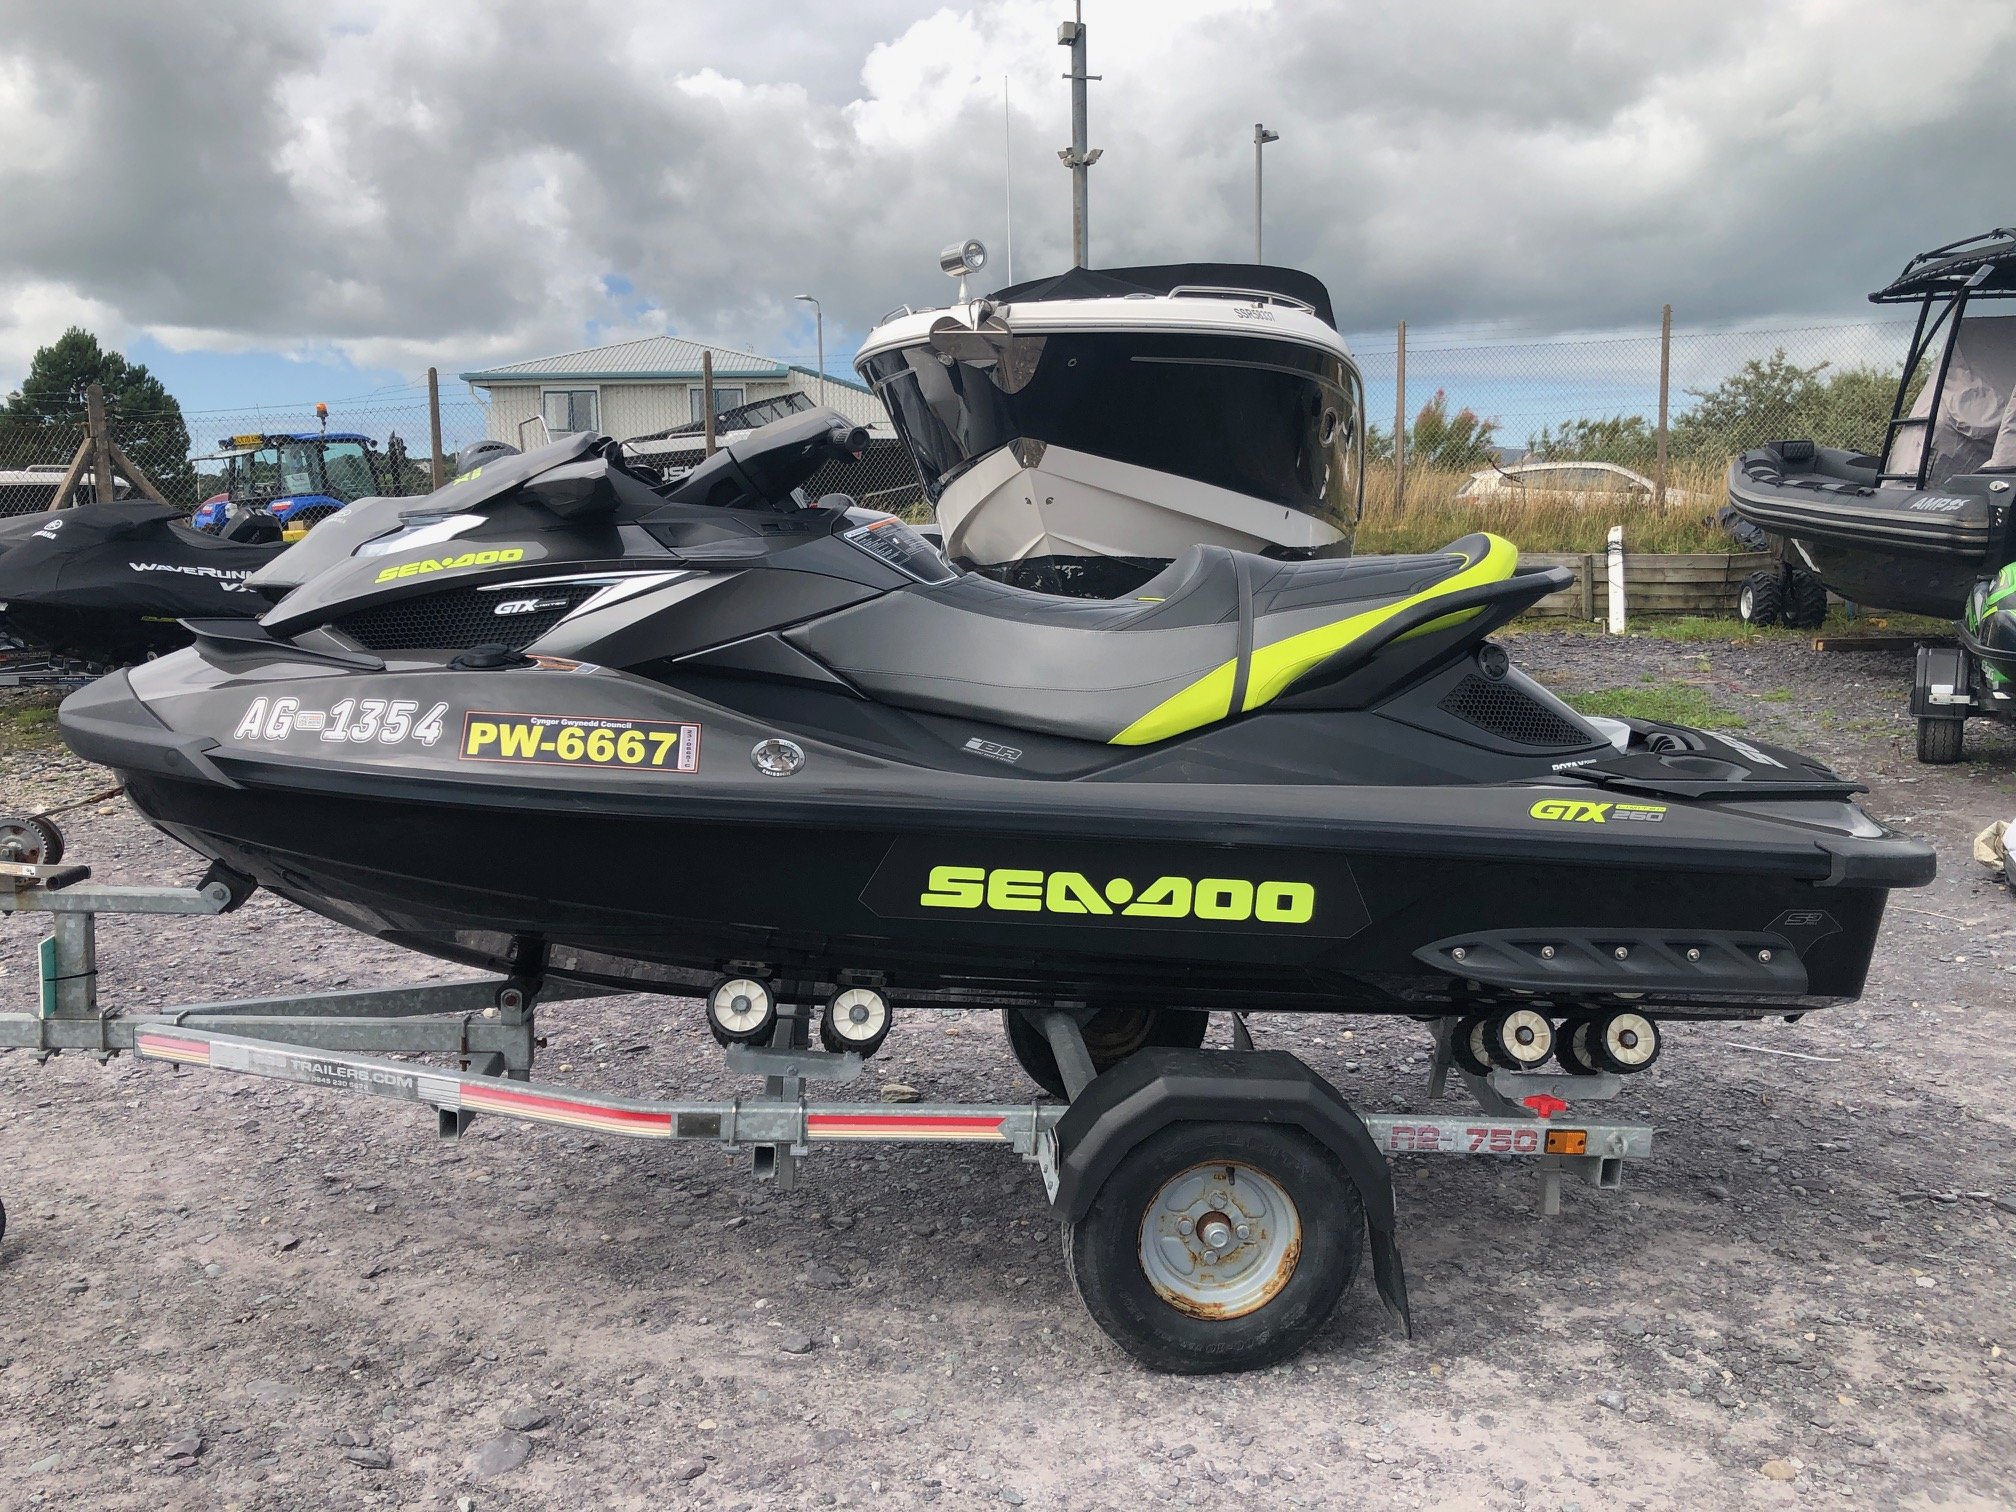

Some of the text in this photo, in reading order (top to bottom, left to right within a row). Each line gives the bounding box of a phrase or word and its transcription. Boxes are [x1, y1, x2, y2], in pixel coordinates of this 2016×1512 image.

[494, 599, 539, 615] GTX
[530, 717, 632, 729] Cyngor Gwynedd Council
[466, 722, 678, 766] PW-6667
[1529, 799, 1614, 823] GTX
[1466, 1127, 1538, 1153] 750
